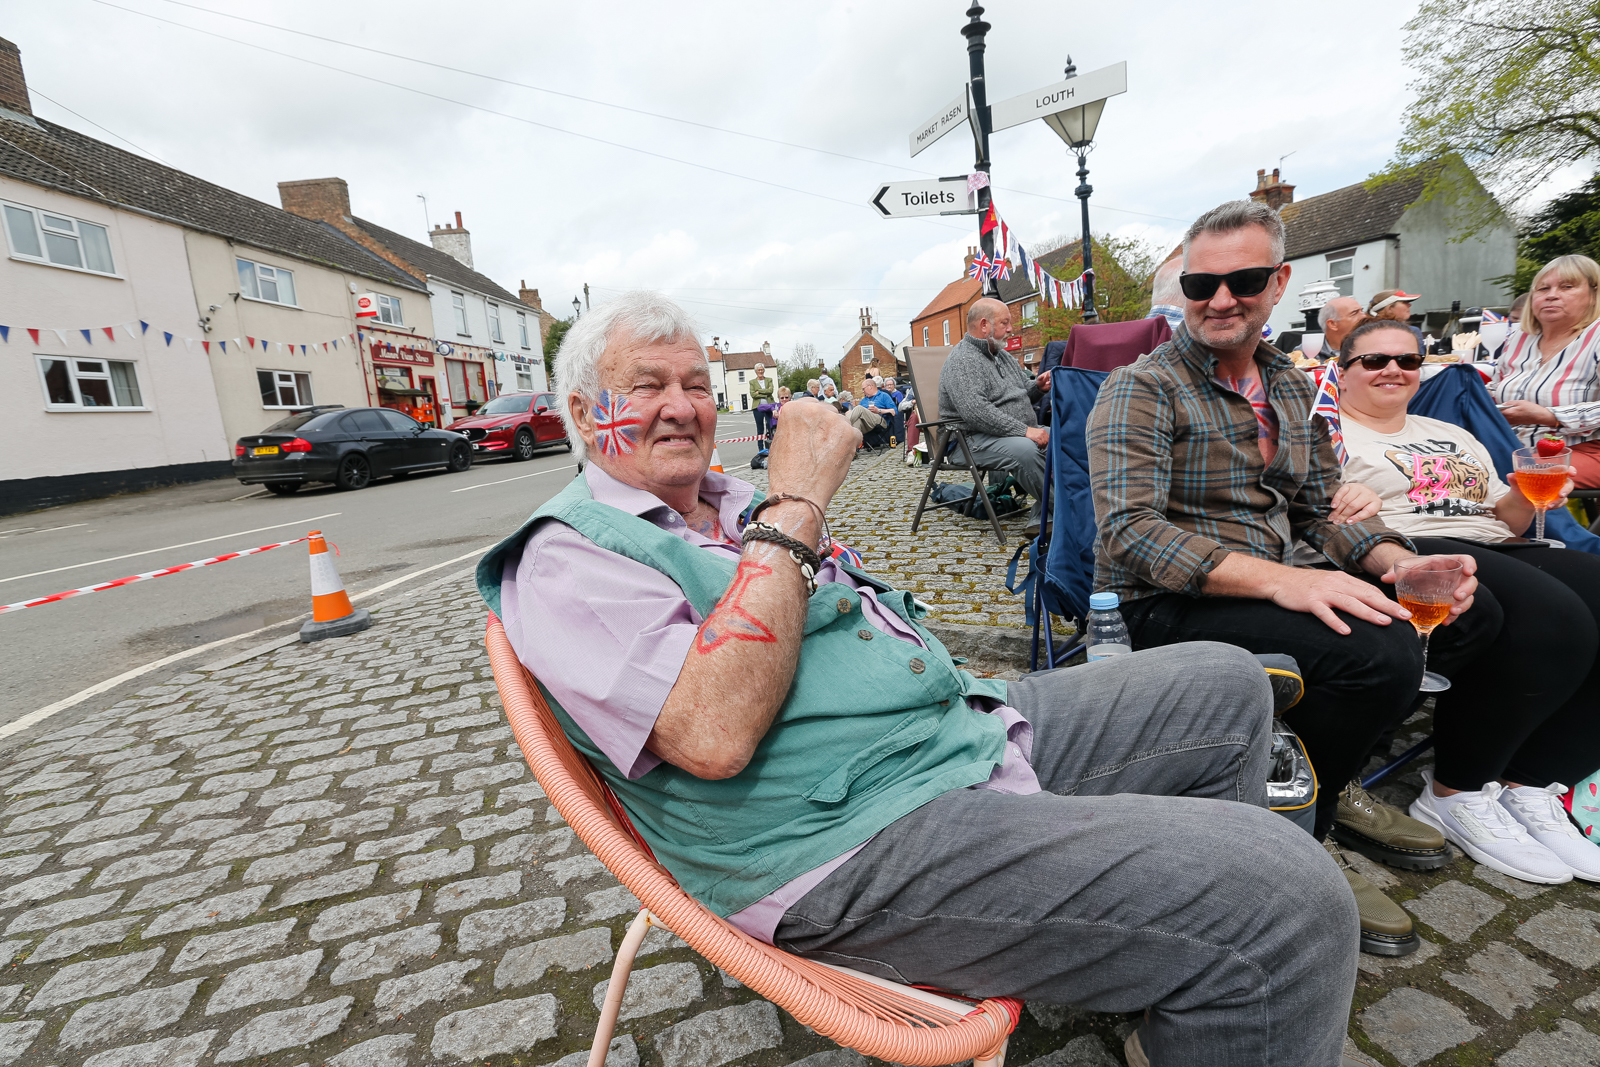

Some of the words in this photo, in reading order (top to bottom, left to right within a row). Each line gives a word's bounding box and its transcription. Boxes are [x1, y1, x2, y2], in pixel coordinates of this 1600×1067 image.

[1035, 87, 1075, 108] LOUTH
[916, 121, 939, 144] MARKET
[941, 104, 962, 126] RASEN
[901, 190, 955, 206] Toilets
